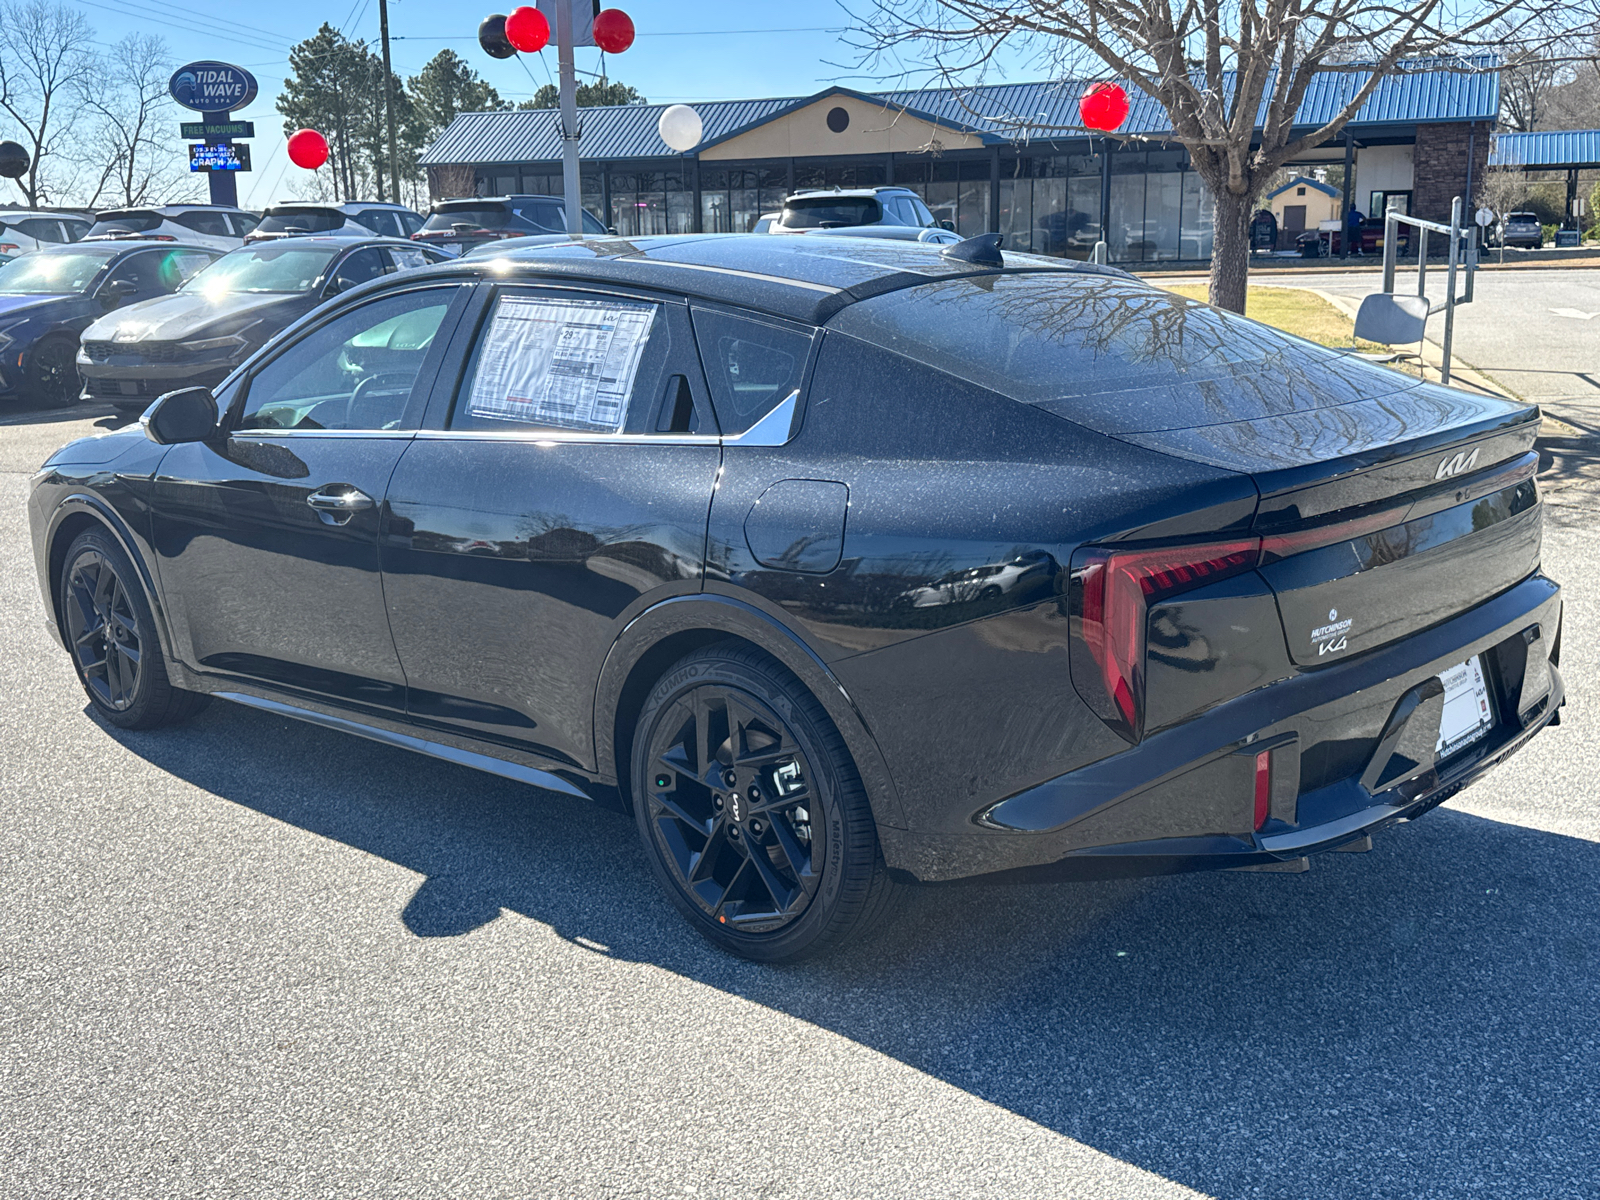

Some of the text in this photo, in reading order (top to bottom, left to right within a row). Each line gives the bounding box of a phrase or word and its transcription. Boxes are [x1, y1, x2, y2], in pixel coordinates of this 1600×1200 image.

[196, 71, 234, 84] TIDAL
[203, 84, 242, 97] WAVE
[183, 124, 243, 135] FREE VACUUMS
[563, 330, 574, 340] 29
[1434, 447, 1480, 479] KIA
[1311, 618, 1353, 638] HUTCHINSON
[1318, 635, 1348, 656] K4
[653, 665, 699, 705] KUMHO
[732, 793, 740, 822] KIA
